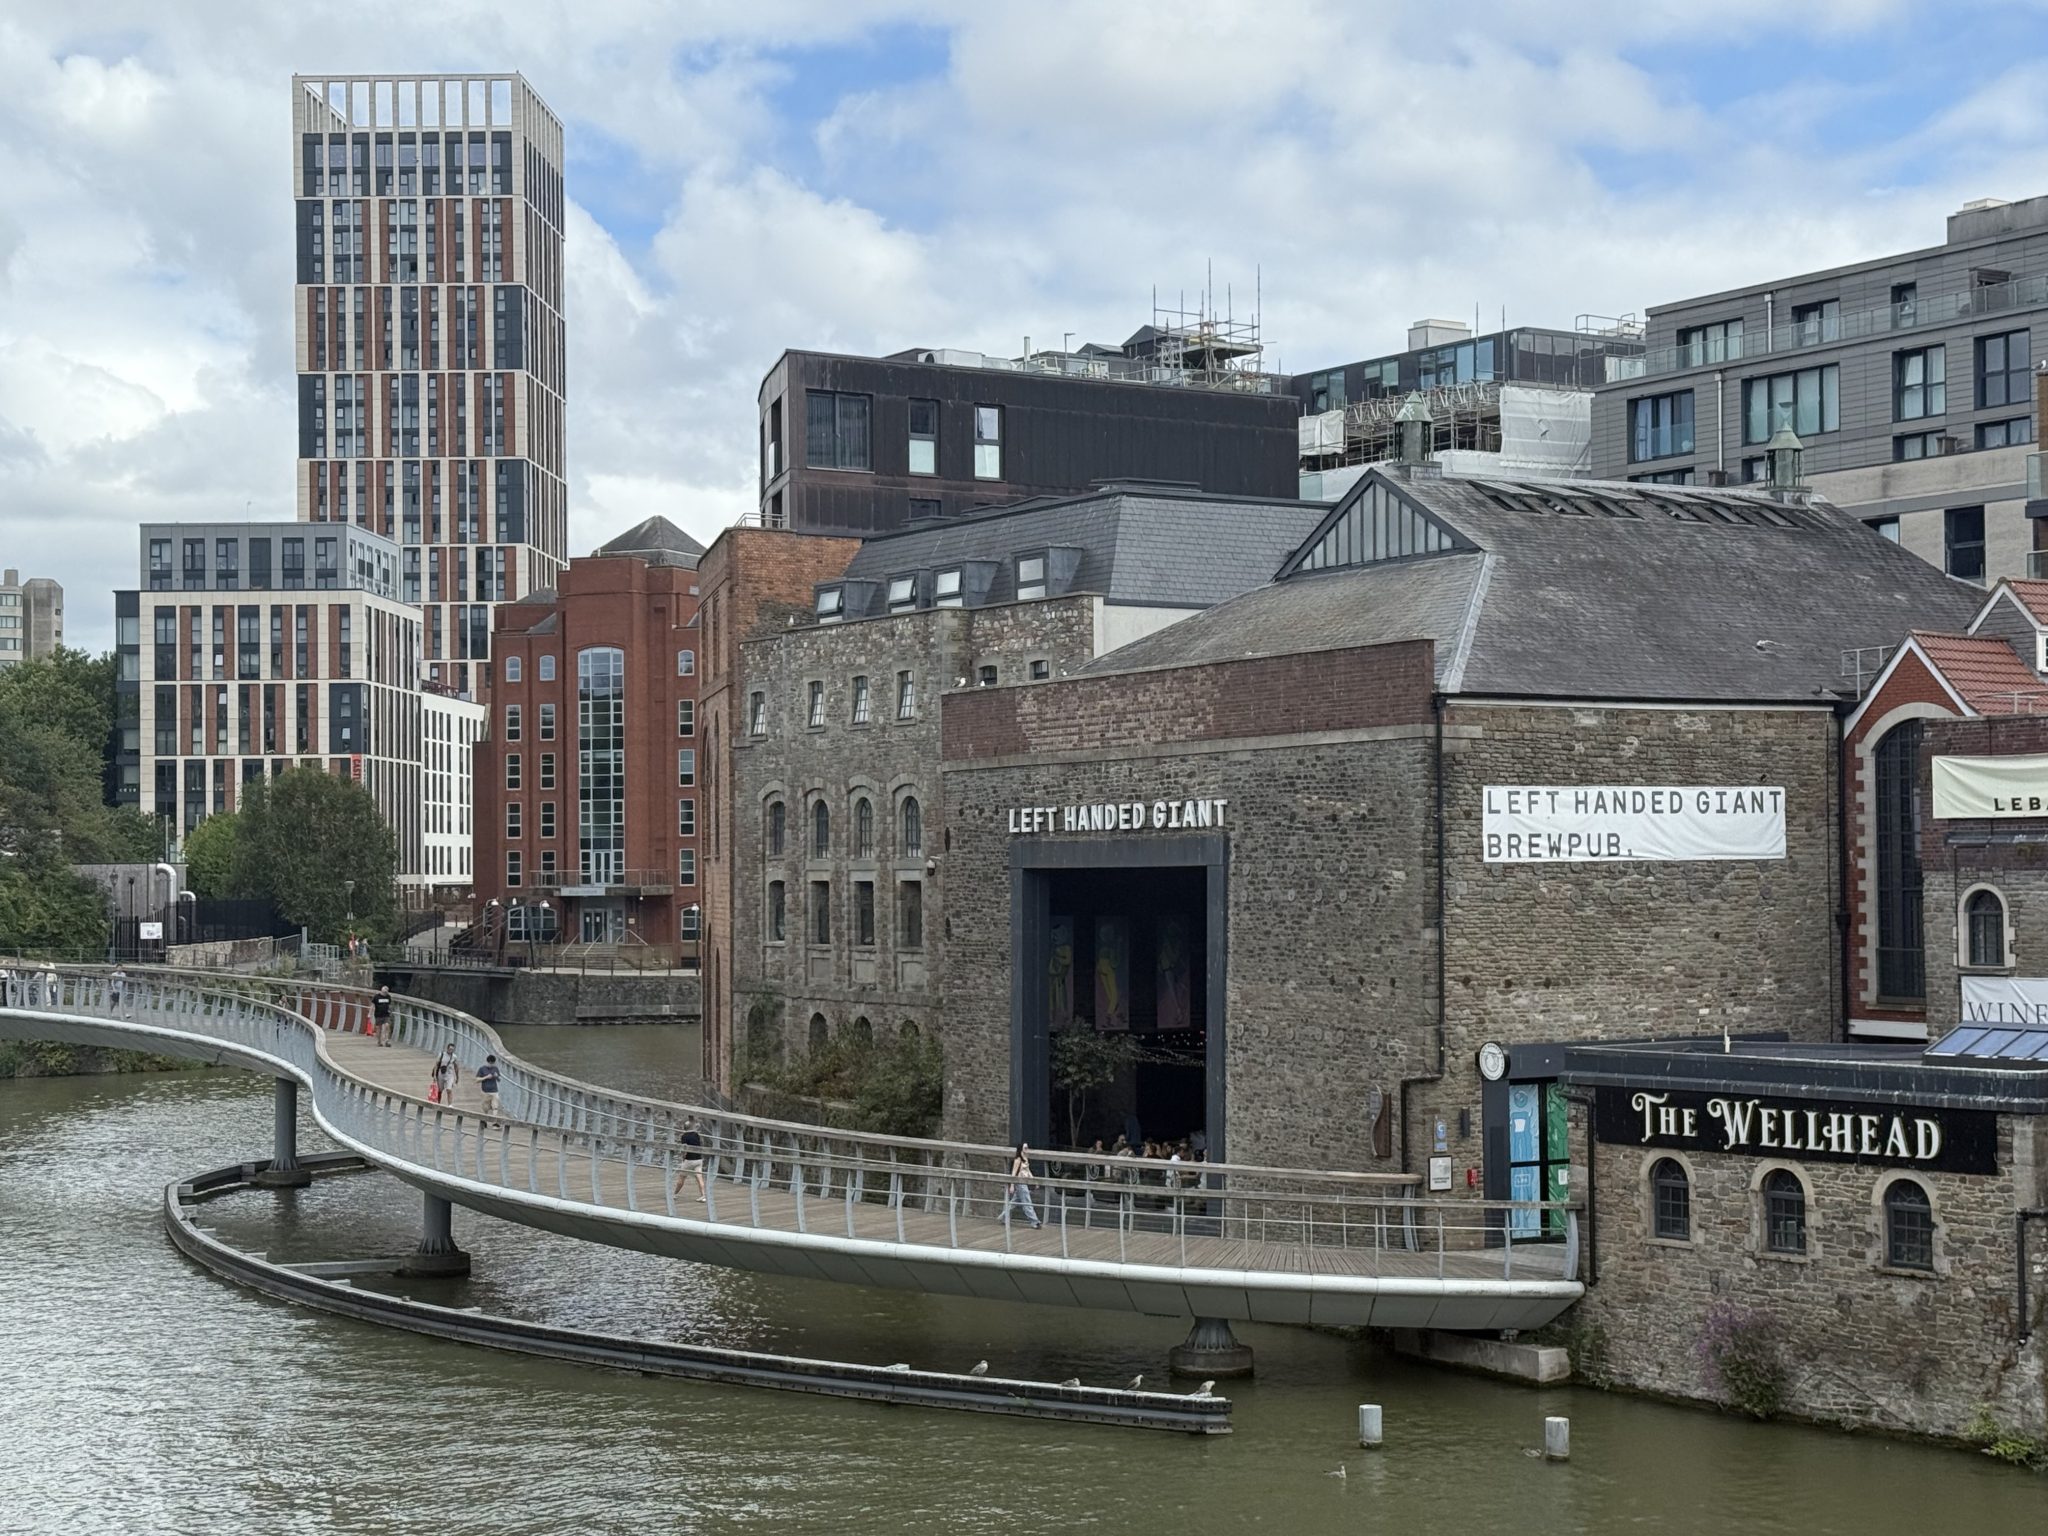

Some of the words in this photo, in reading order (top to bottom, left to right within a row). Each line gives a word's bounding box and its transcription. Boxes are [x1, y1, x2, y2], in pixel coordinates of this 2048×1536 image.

[1487, 790, 1560, 815] LEFT
[1574, 790, 1684, 815] HANDED
[1696, 790, 1782, 814] GIANT
[1993, 797, 2048, 812] LEB
[1008, 806, 1057, 833] LEFT
[1064, 802, 1146, 832] HANDED
[1152, 799, 1228, 828] GIANT
